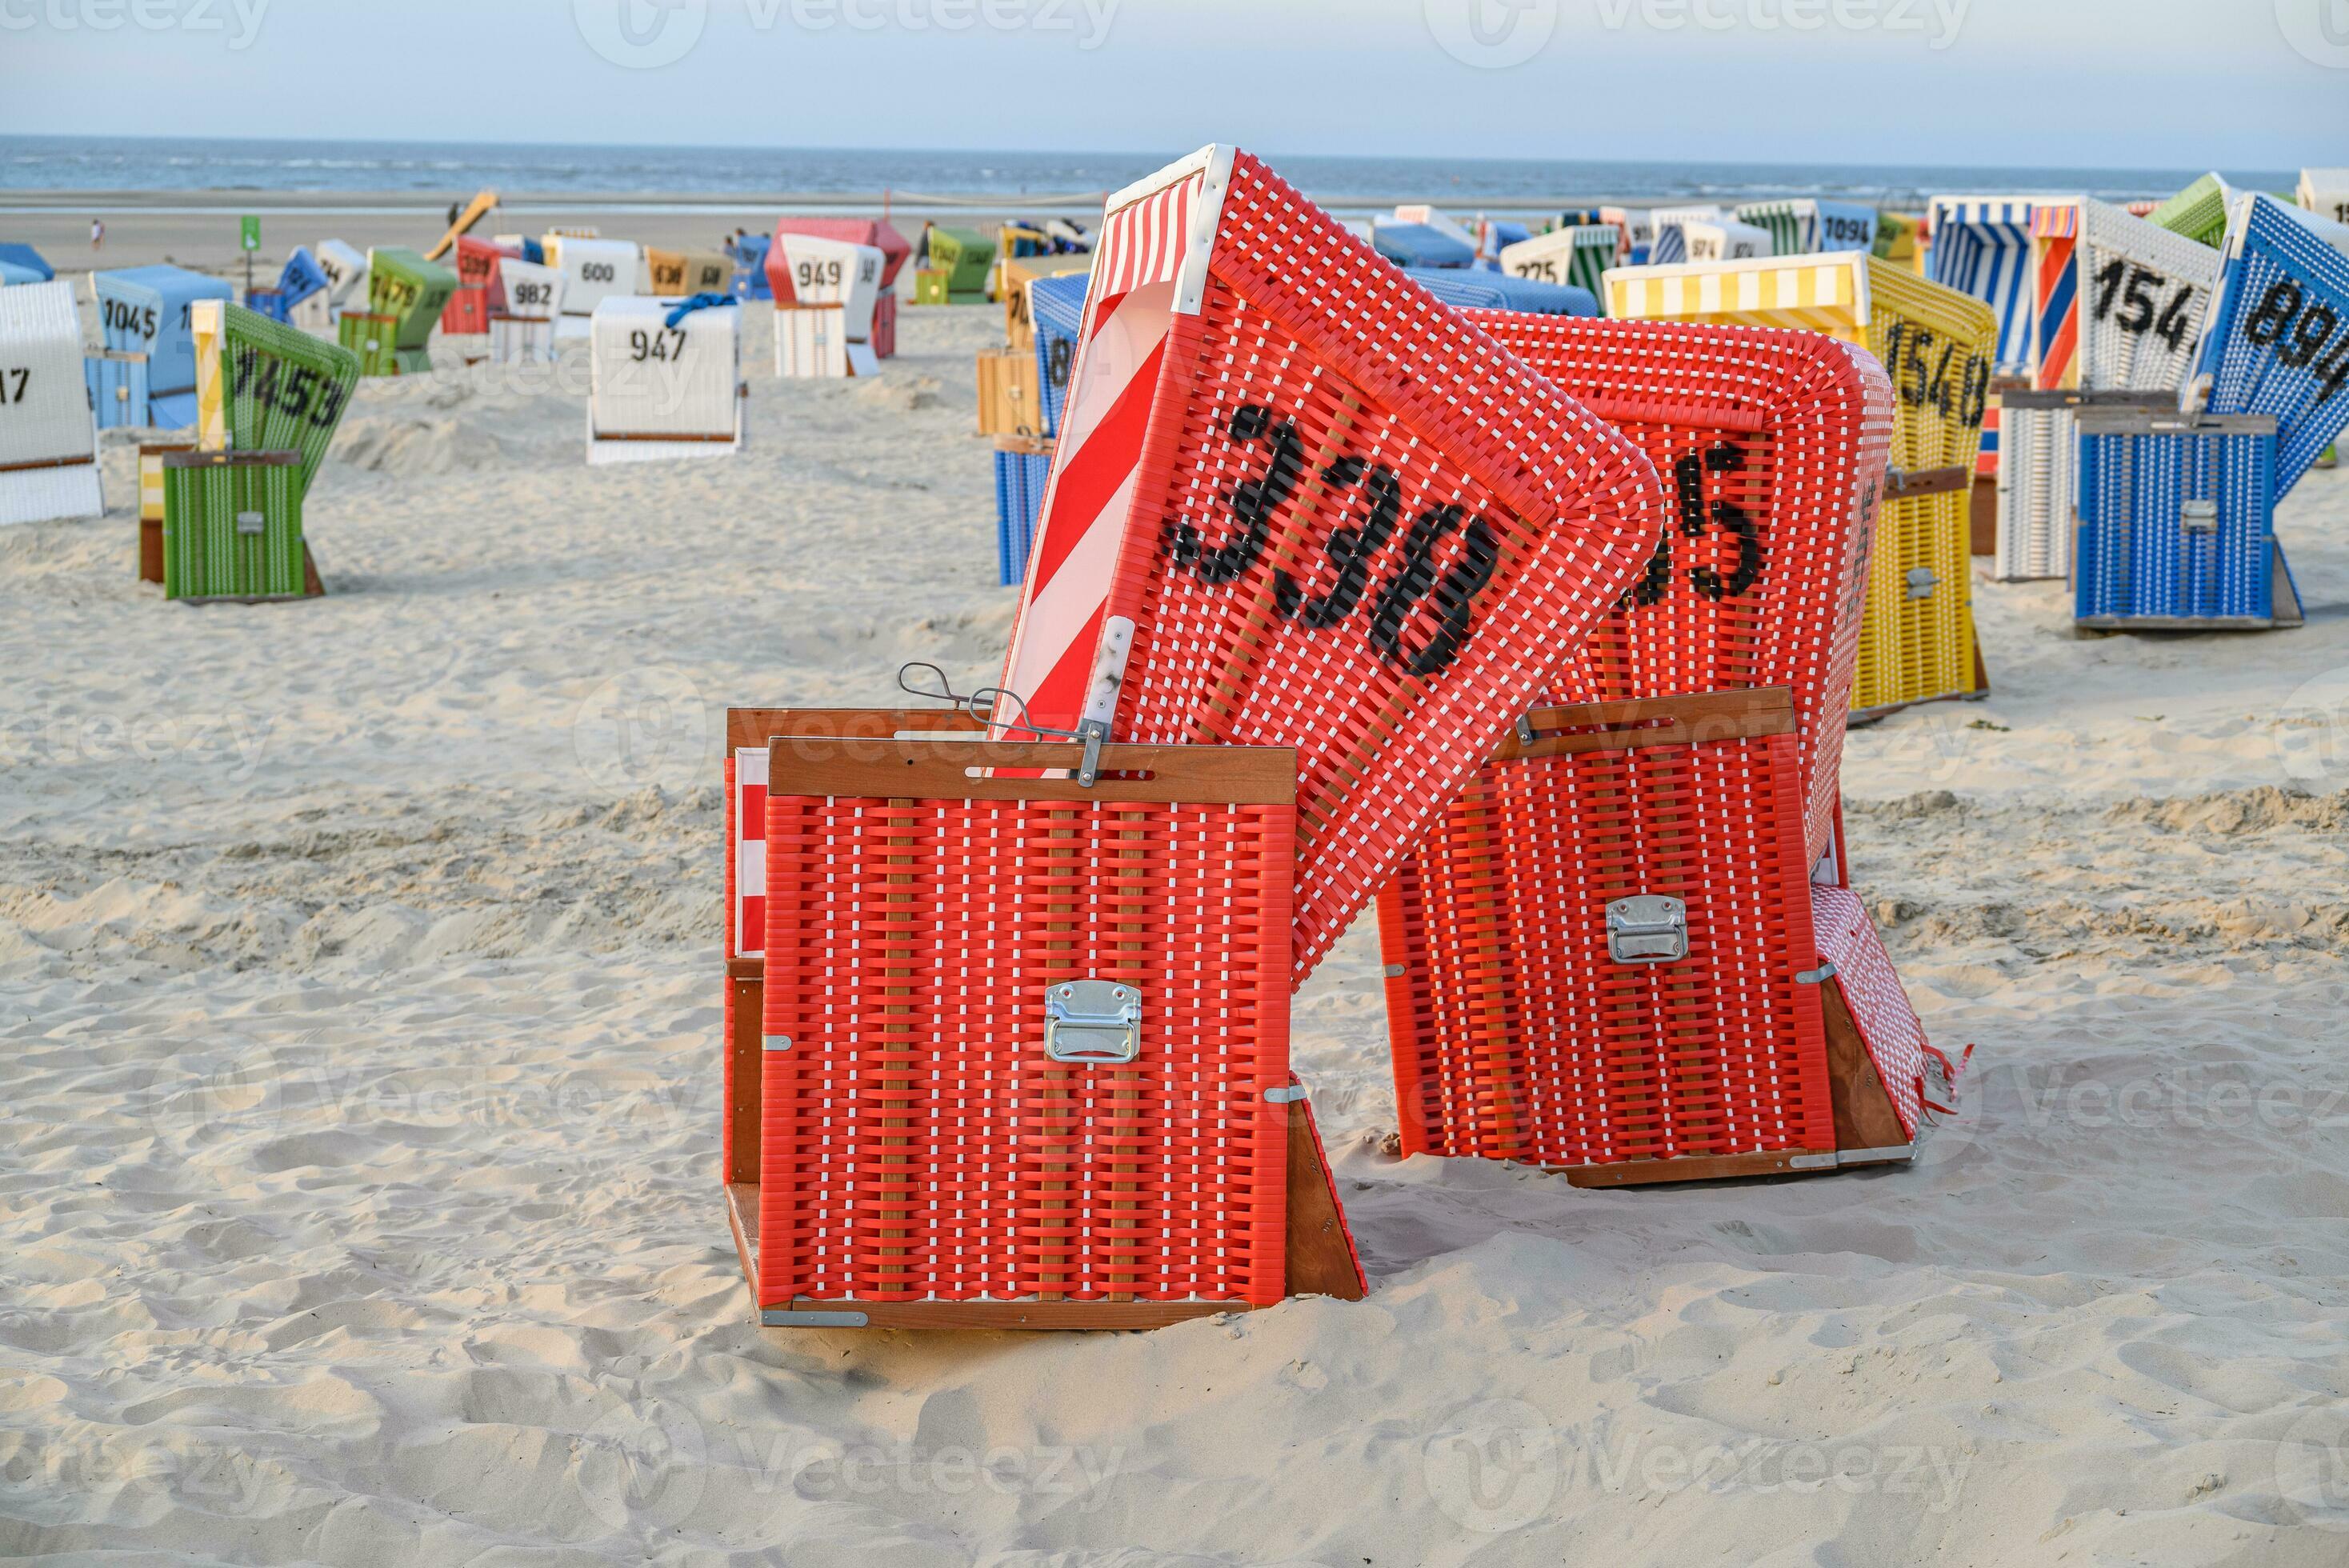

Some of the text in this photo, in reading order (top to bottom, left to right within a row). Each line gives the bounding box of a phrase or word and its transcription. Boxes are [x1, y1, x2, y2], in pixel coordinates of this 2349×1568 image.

[582, 262, 614, 282] 600
[799, 262, 842, 287] 949
[514, 283, 552, 306] 982
[2094, 259, 2197, 358] 154
[105, 298, 158, 341] 1045
[630, 329, 687, 362] 947
[235, 349, 343, 428] 1453
[1162, 403, 1499, 678] 338
